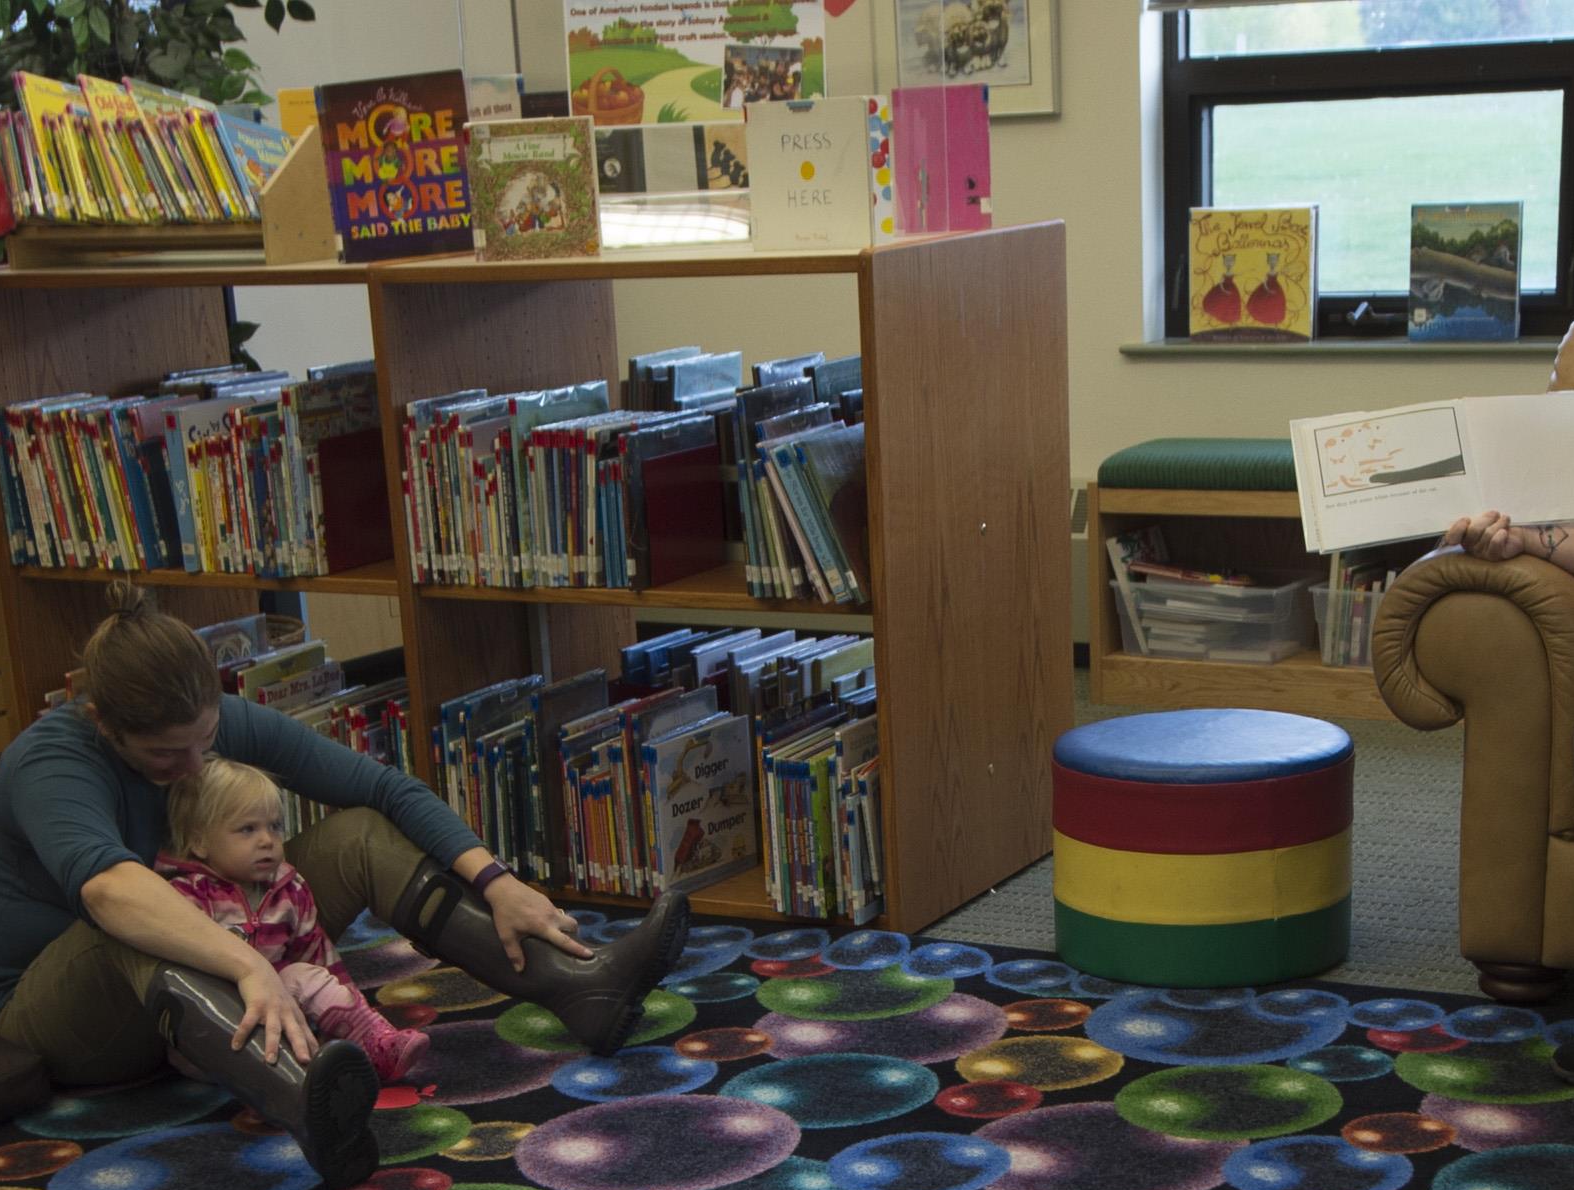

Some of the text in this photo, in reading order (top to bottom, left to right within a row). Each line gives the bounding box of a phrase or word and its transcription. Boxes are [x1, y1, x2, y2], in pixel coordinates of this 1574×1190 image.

[589, 7, 598, 15] of
[656, 17, 677, 29] story
[678, 17, 687, 26] of
[335, 103, 456, 151] MORE
[781, 133, 832, 152] PRESS
[340, 143, 461, 187] MORE
[346, 179, 467, 221] MORE
[787, 188, 833, 208] HERE
[350, 213, 472, 240] SAID THE BABY
[694, 757, 730, 779] Digger
[672, 796, 704, 817] Dozer
[707, 811, 747, 835] Dumper
